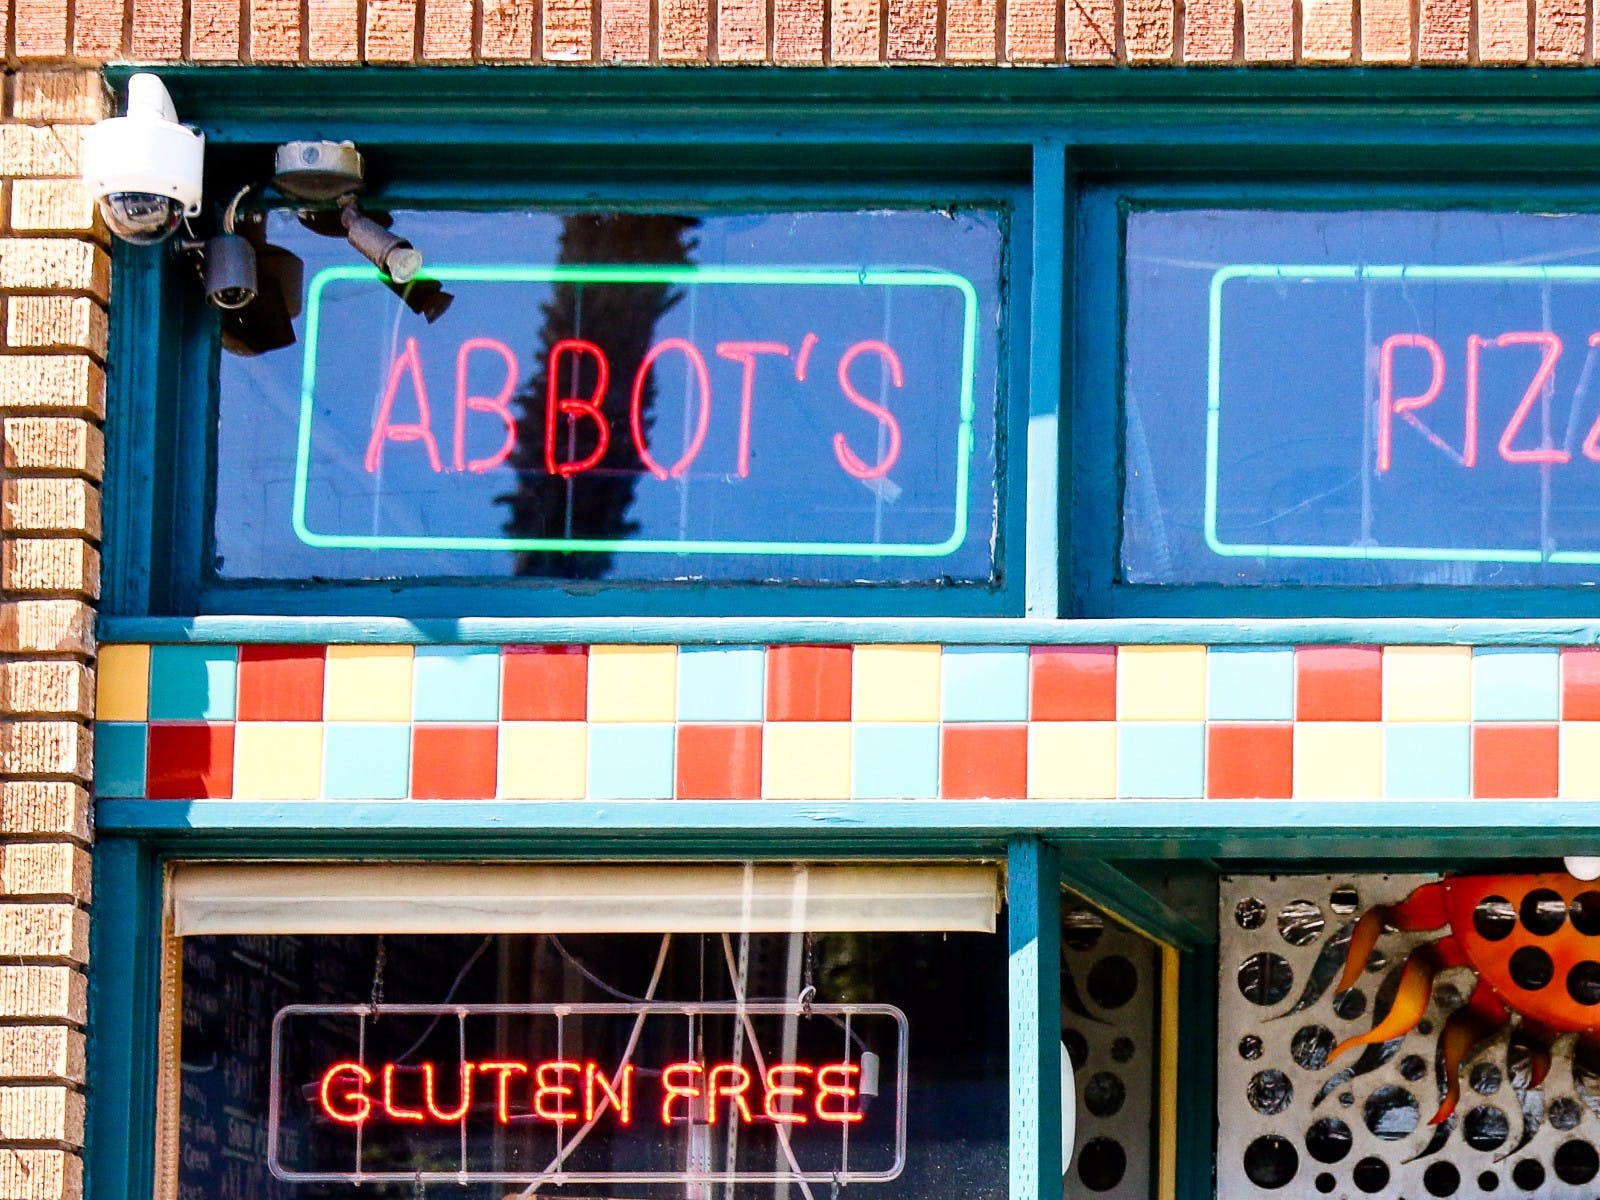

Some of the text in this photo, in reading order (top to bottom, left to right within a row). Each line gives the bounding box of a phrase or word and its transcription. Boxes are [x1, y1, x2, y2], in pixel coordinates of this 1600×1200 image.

[365, 333, 903, 481] ABBOT'S
[318, 1060, 635, 1126] GLUTEN
[661, 1061, 865, 1127] FREE
